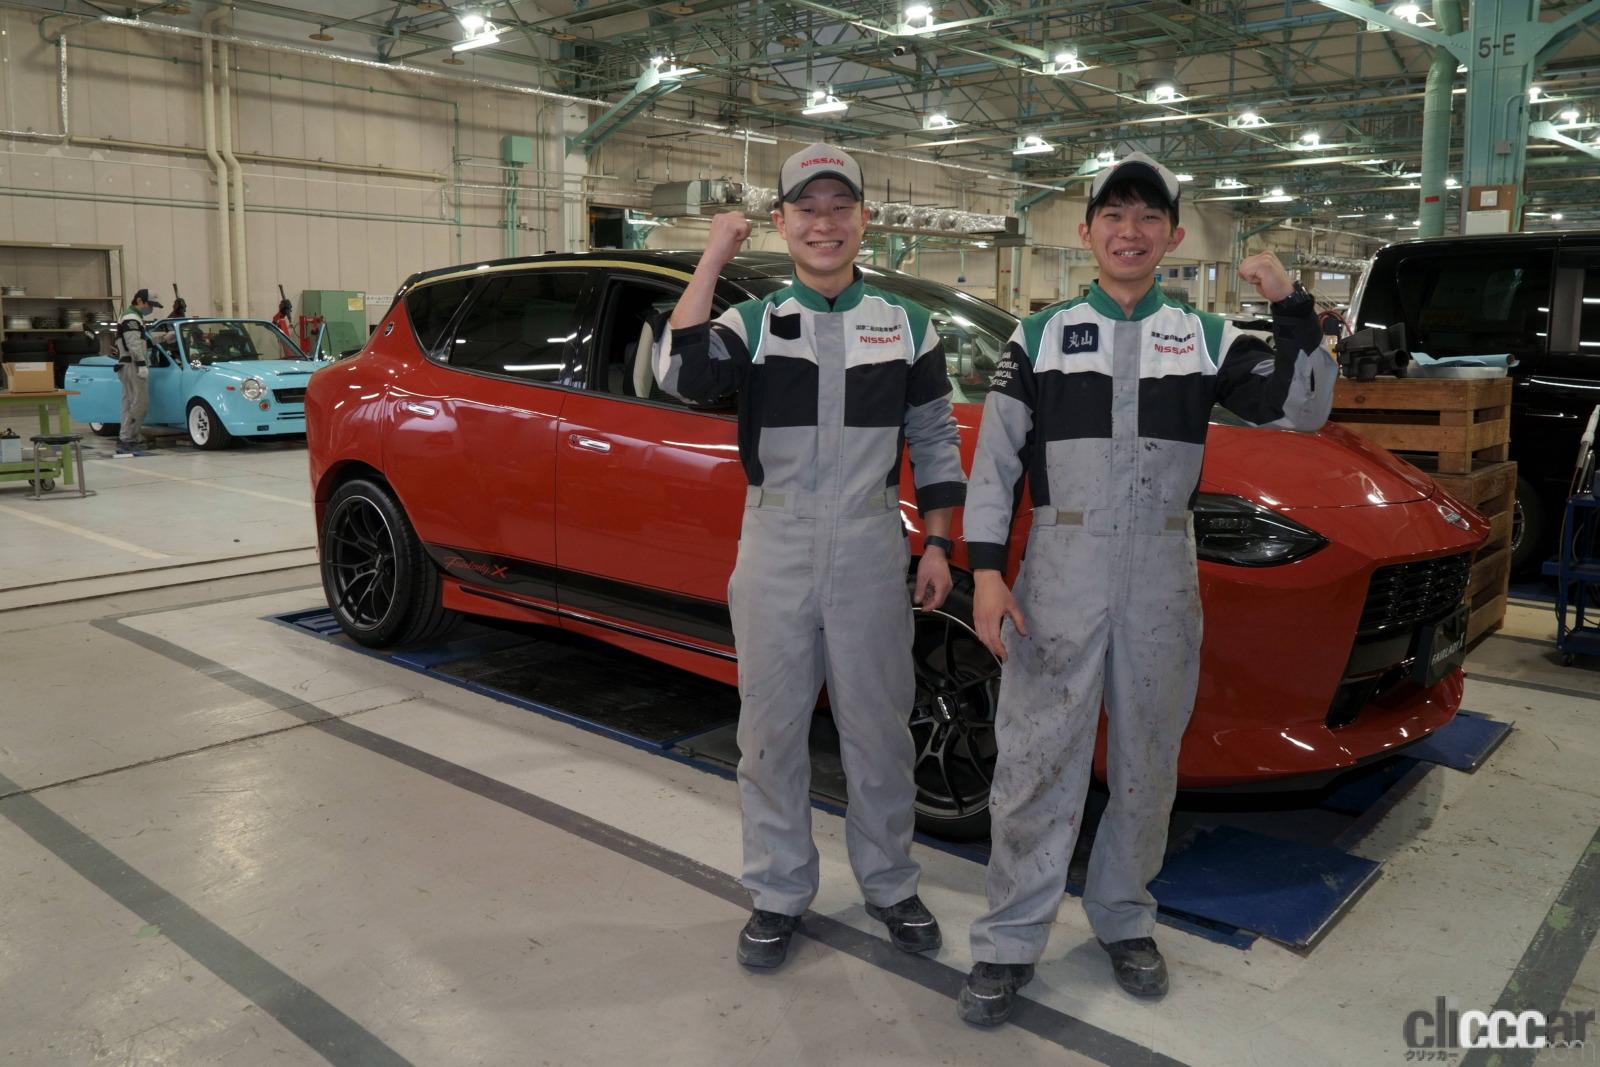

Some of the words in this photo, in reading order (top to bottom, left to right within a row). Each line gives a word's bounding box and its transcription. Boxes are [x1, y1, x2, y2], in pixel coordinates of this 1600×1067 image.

[1478, 34, 1516, 58] 5-E
[801, 157, 845, 169] NISSAN
[860, 334, 901, 344] NISSAN
[1068, 330, 1093, 349] 丸山
[1154, 343, 1195, 355] NISSAN
